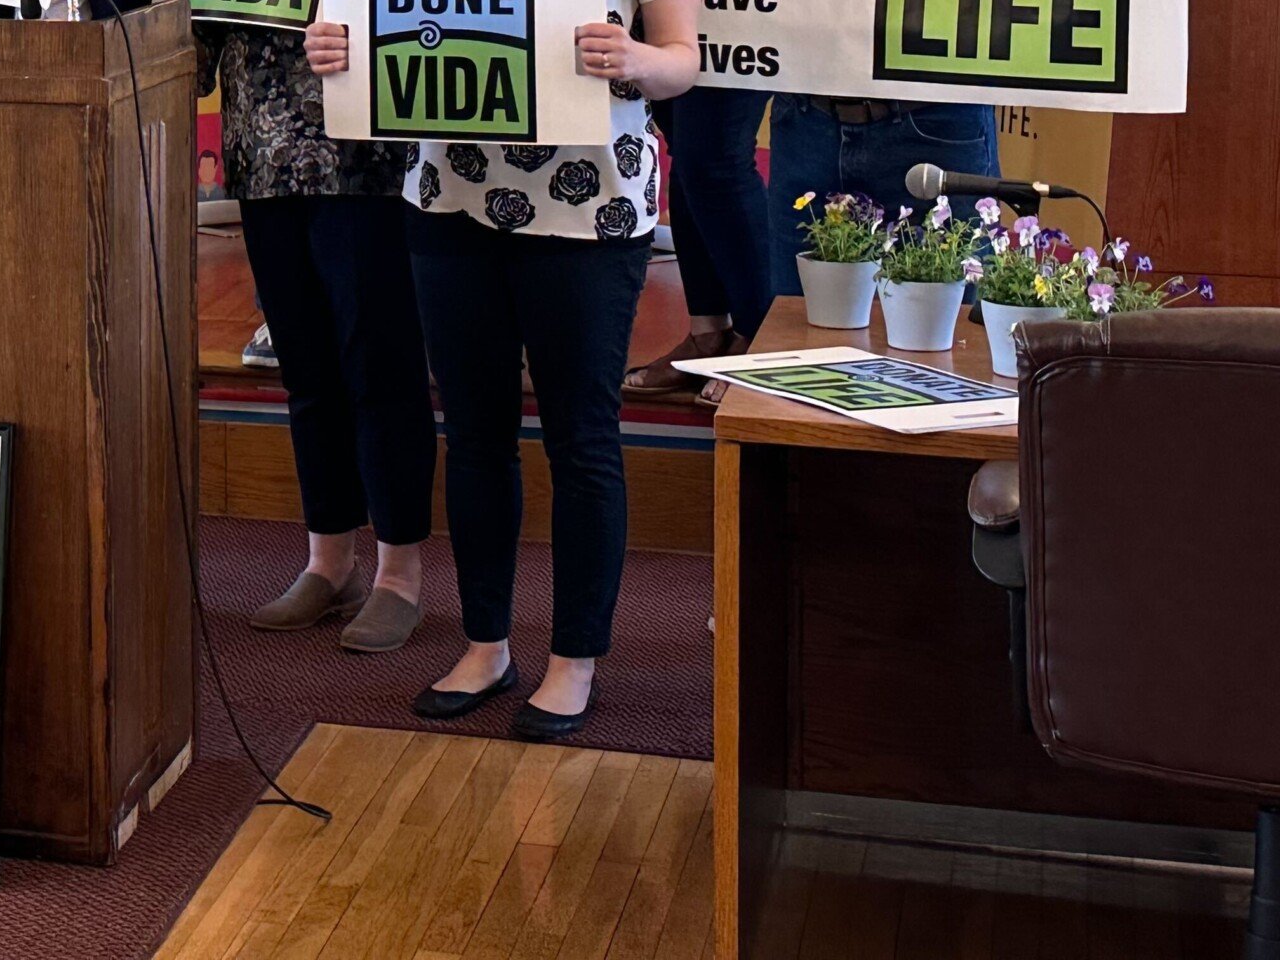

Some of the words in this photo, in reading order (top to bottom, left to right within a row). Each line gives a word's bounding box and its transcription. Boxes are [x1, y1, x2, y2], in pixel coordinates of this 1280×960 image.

[698, 34, 780, 77] ives
[384, 55, 519, 123] VIDA
[748, 370, 917, 406] LIFE
[851, 361, 998, 398] DONATE
